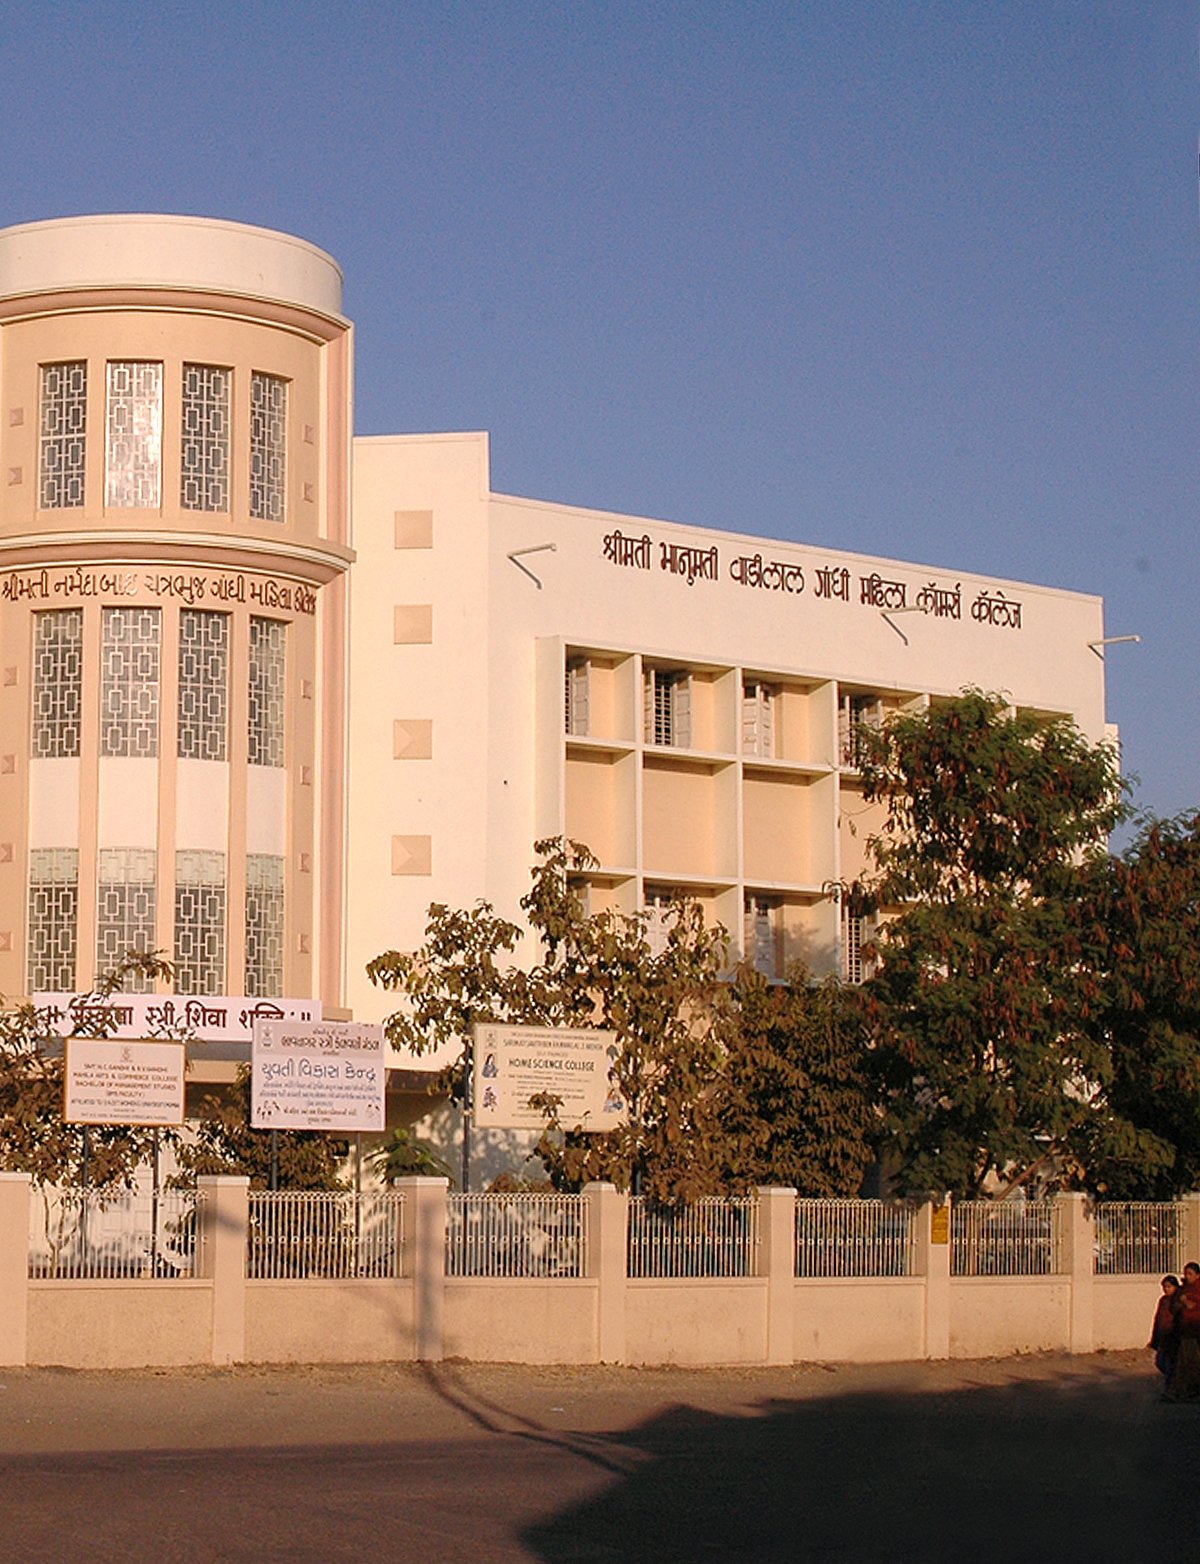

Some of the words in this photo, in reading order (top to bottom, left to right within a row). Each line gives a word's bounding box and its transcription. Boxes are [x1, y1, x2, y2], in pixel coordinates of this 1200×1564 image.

[603, 530, 652, 570] श्रीमती
[659, 542, 719, 586] भानुमती
[814, 566, 851, 601] गांधी
[859, 573, 907, 609] महिला
[2, 569, 49, 601] શ્રીમતી
[185, 1000, 227, 1028] शिवा
[262, 1058, 295, 1080] યુવતી
[298, 1058, 339, 1078] વિકાસ
[509, 1057, 531, 1068] HOME
[533, 1058, 562, 1070] SCIENCE
[565, 1060, 595, 1072] COLLEGE
